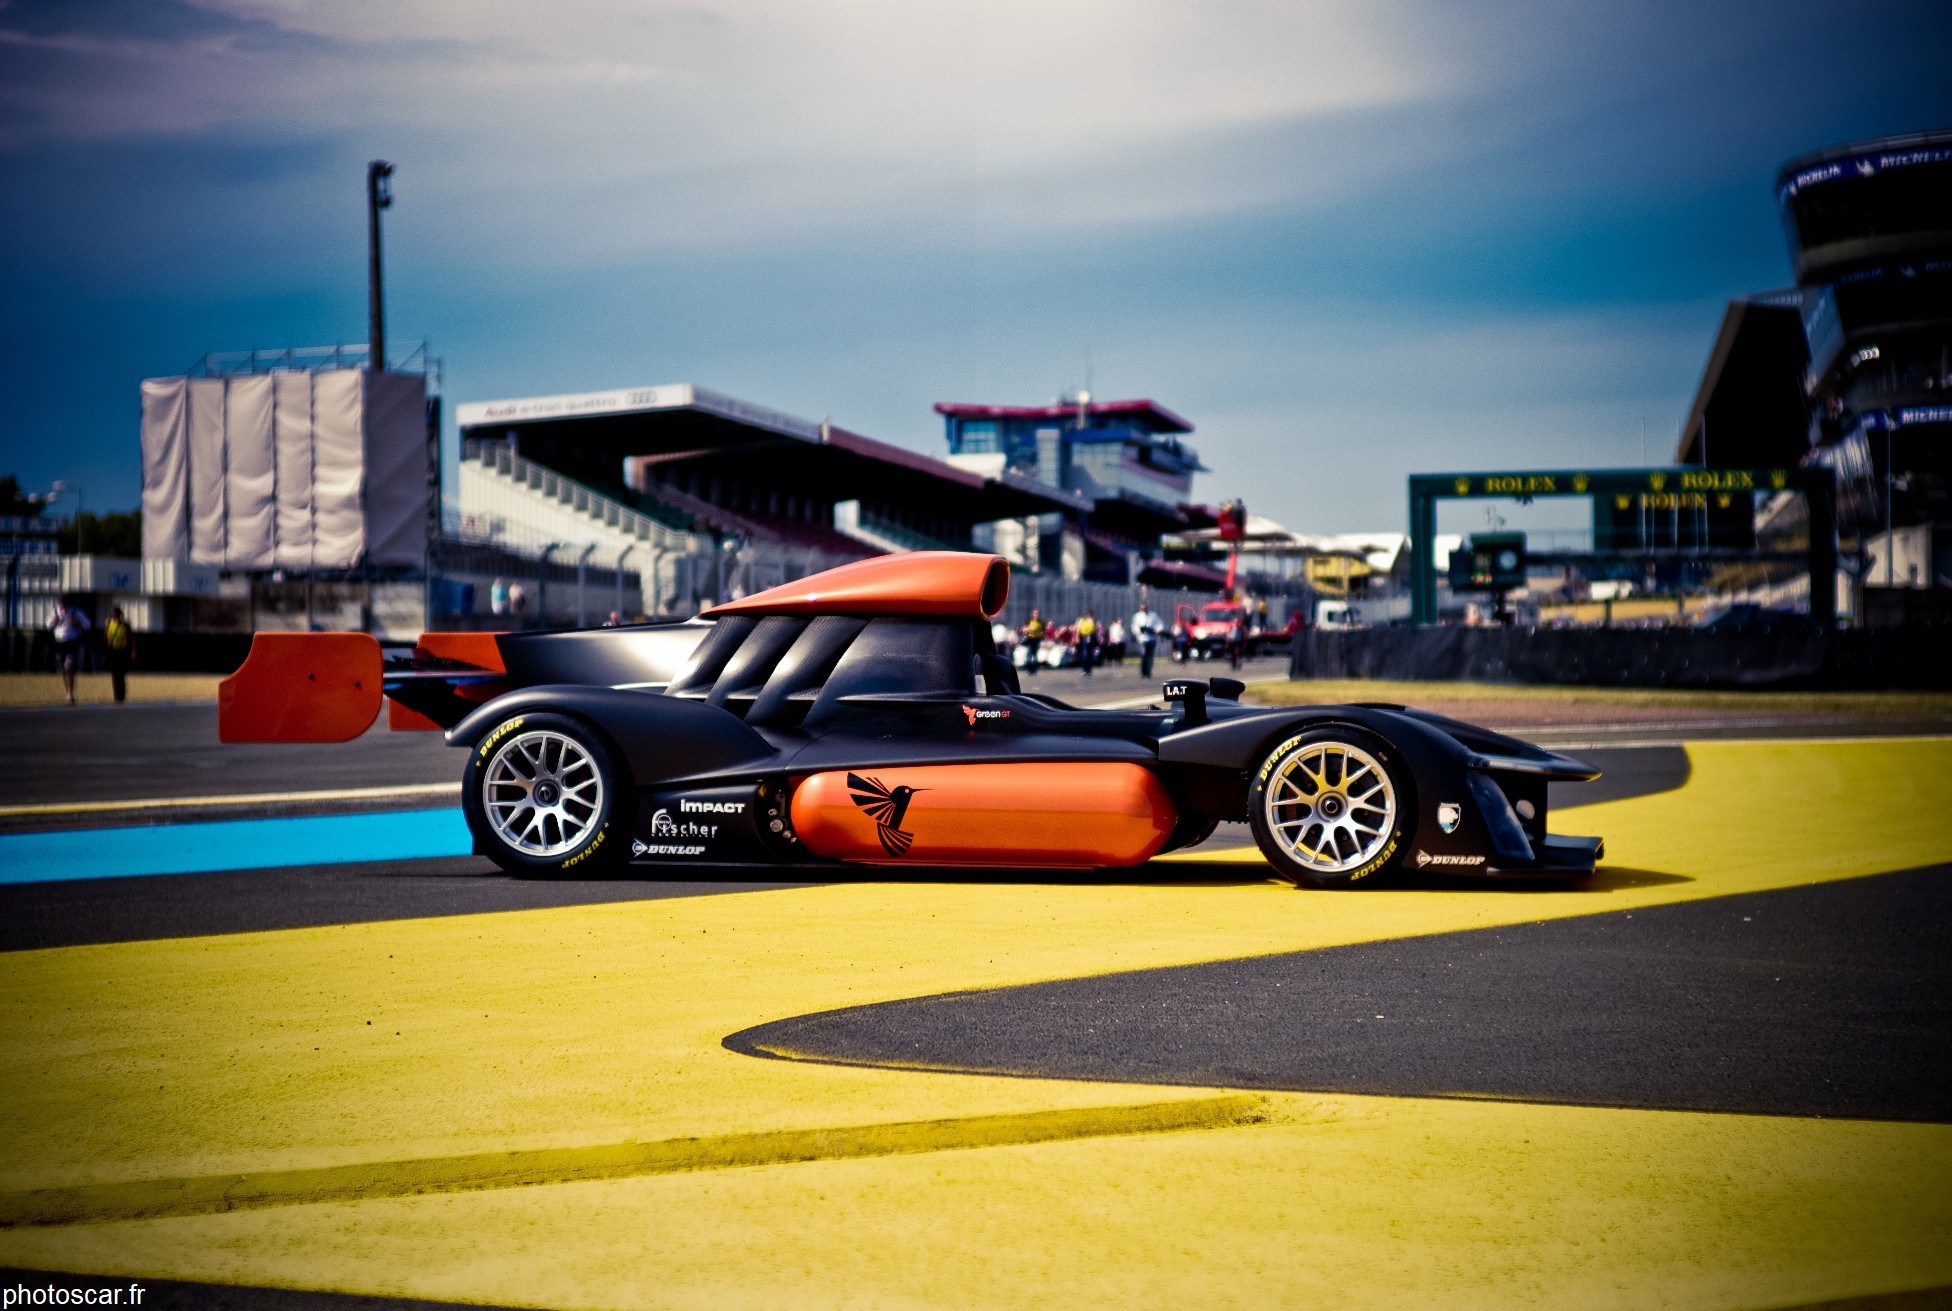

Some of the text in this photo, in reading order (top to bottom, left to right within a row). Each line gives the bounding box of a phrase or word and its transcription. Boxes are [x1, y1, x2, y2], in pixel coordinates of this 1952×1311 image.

[485, 404, 517, 419] Audi
[1485, 476, 1557, 493] ROLEX
[1680, 471, 1754, 490] ROLEX
[1640, 492, 1706, 509] ROLEX
[480, 718, 524, 758] DUNLOP
[1260, 735, 1302, 781] DUNLOP
[562, 831, 606, 869] DUNLOP
[647, 844, 706, 855] DUNLOP
[1350, 840, 1398, 881] DUNLOP
[1431, 855, 1486, 866] DUNLOP
